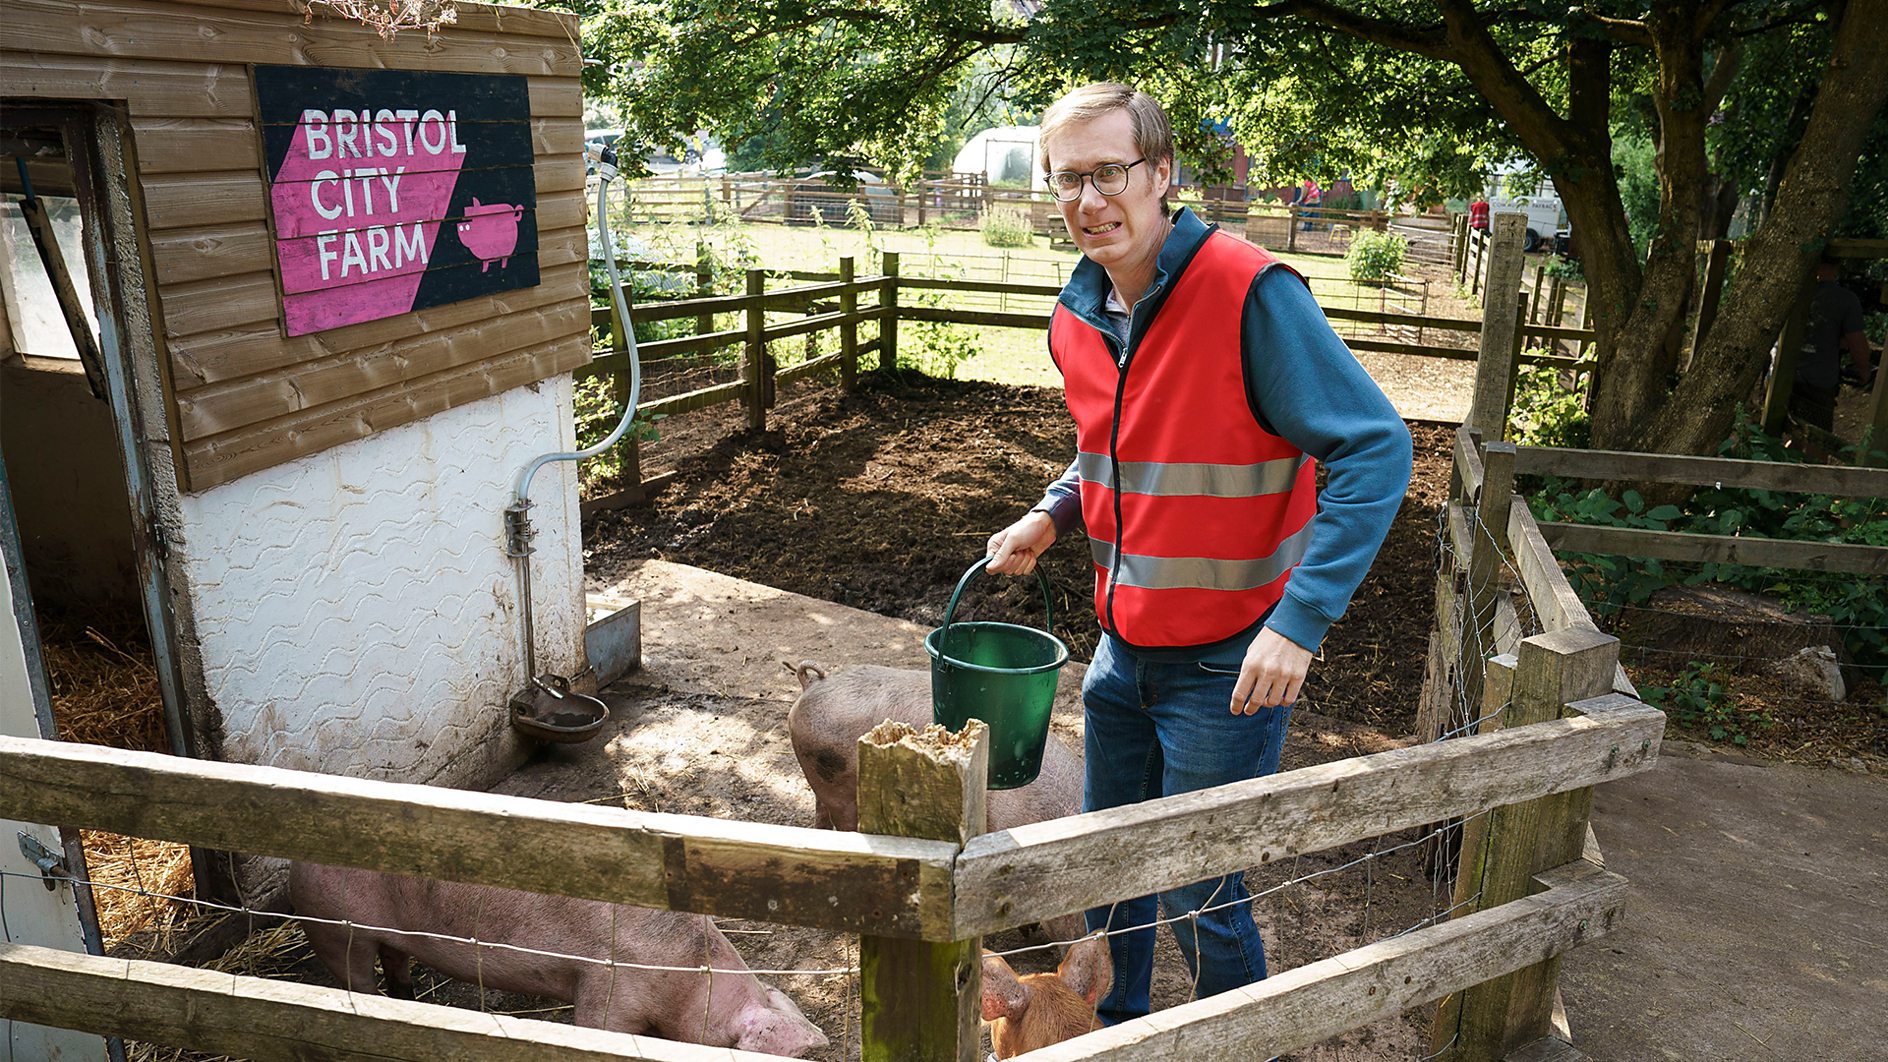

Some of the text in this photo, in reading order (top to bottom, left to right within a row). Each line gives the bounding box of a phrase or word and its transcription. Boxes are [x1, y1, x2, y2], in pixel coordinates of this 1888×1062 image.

[303, 108, 467, 160] BRISTOL
[311, 166, 405, 220] CITY
[317, 220, 428, 281] FARM
